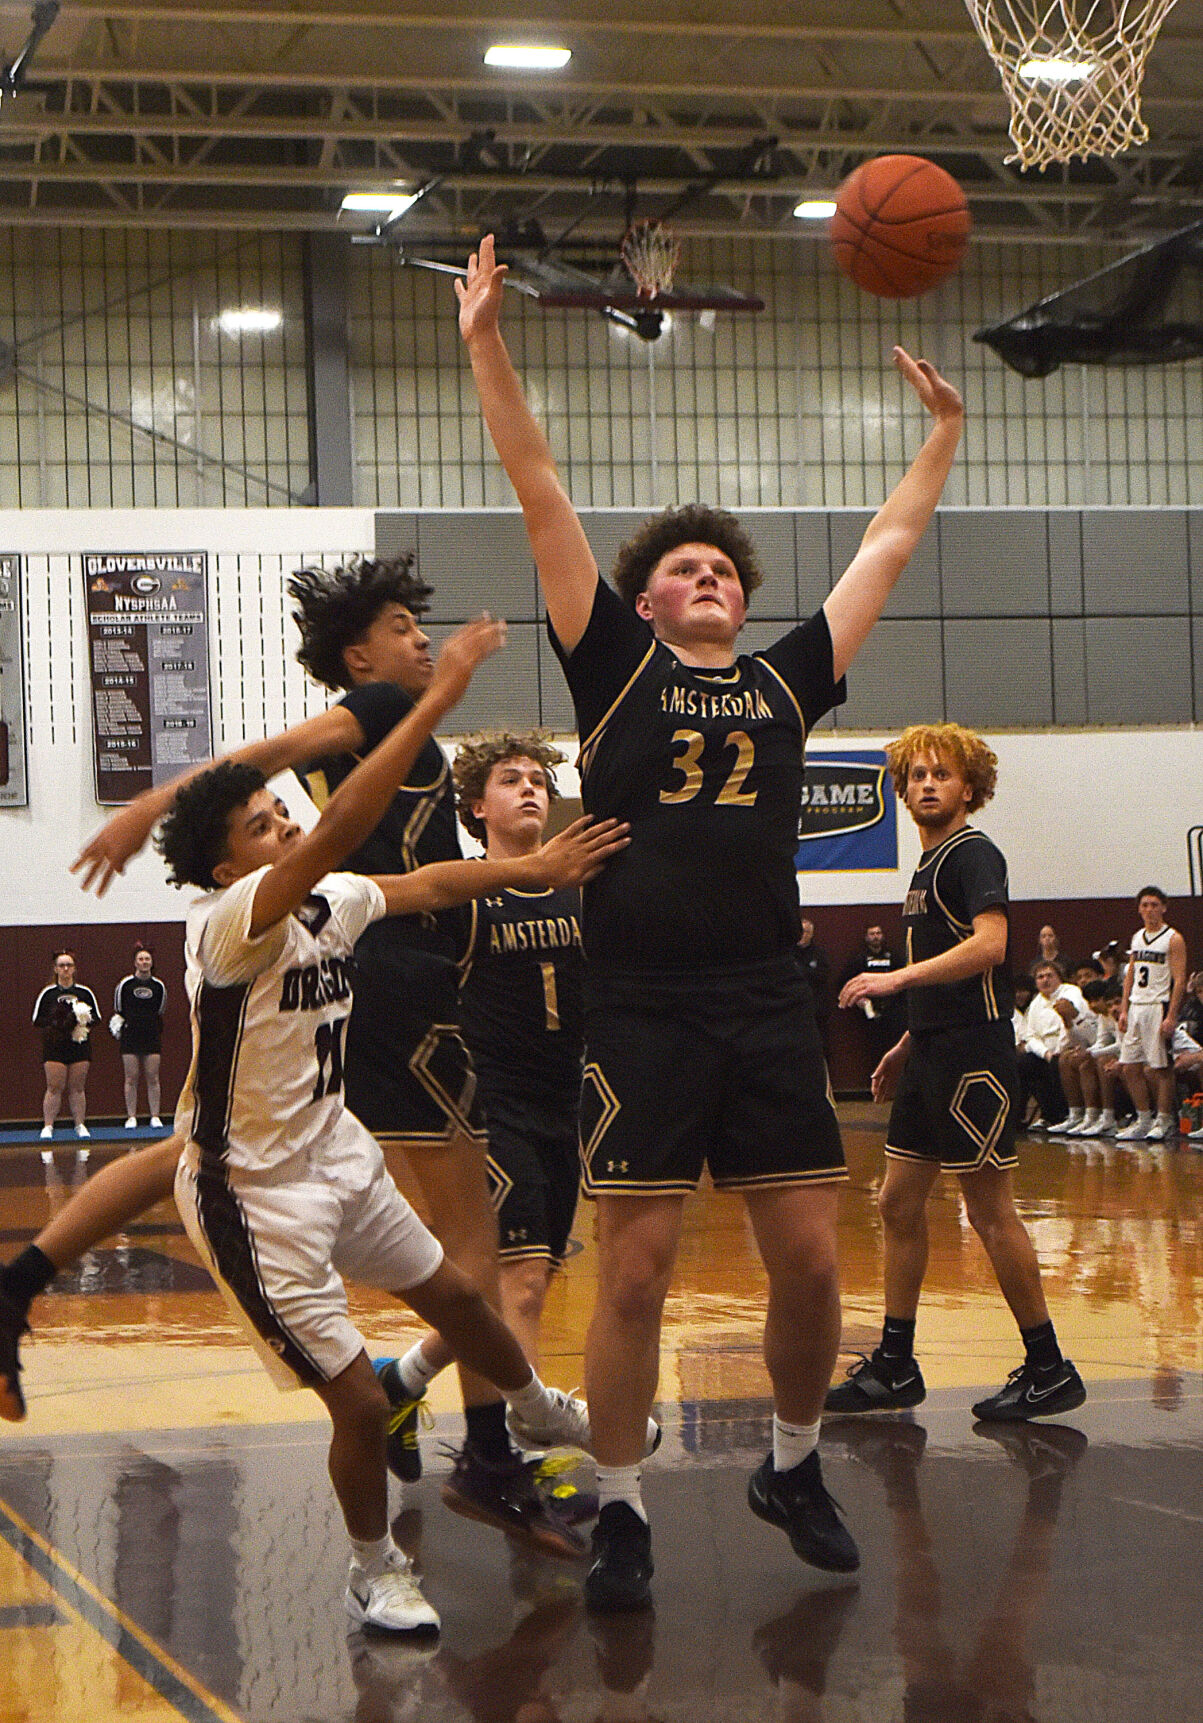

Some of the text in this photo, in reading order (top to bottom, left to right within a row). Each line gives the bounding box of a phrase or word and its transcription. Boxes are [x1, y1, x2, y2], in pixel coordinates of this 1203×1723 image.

[87, 556, 202, 576] GLOVERSVILLE
[114, 593, 178, 611] NYSPHSAA
[174, 614, 201, 622] TEAMS
[658, 728, 758, 806] 32
[1138, 966, 1149, 987] 3
[538, 962, 562, 1031] 1
